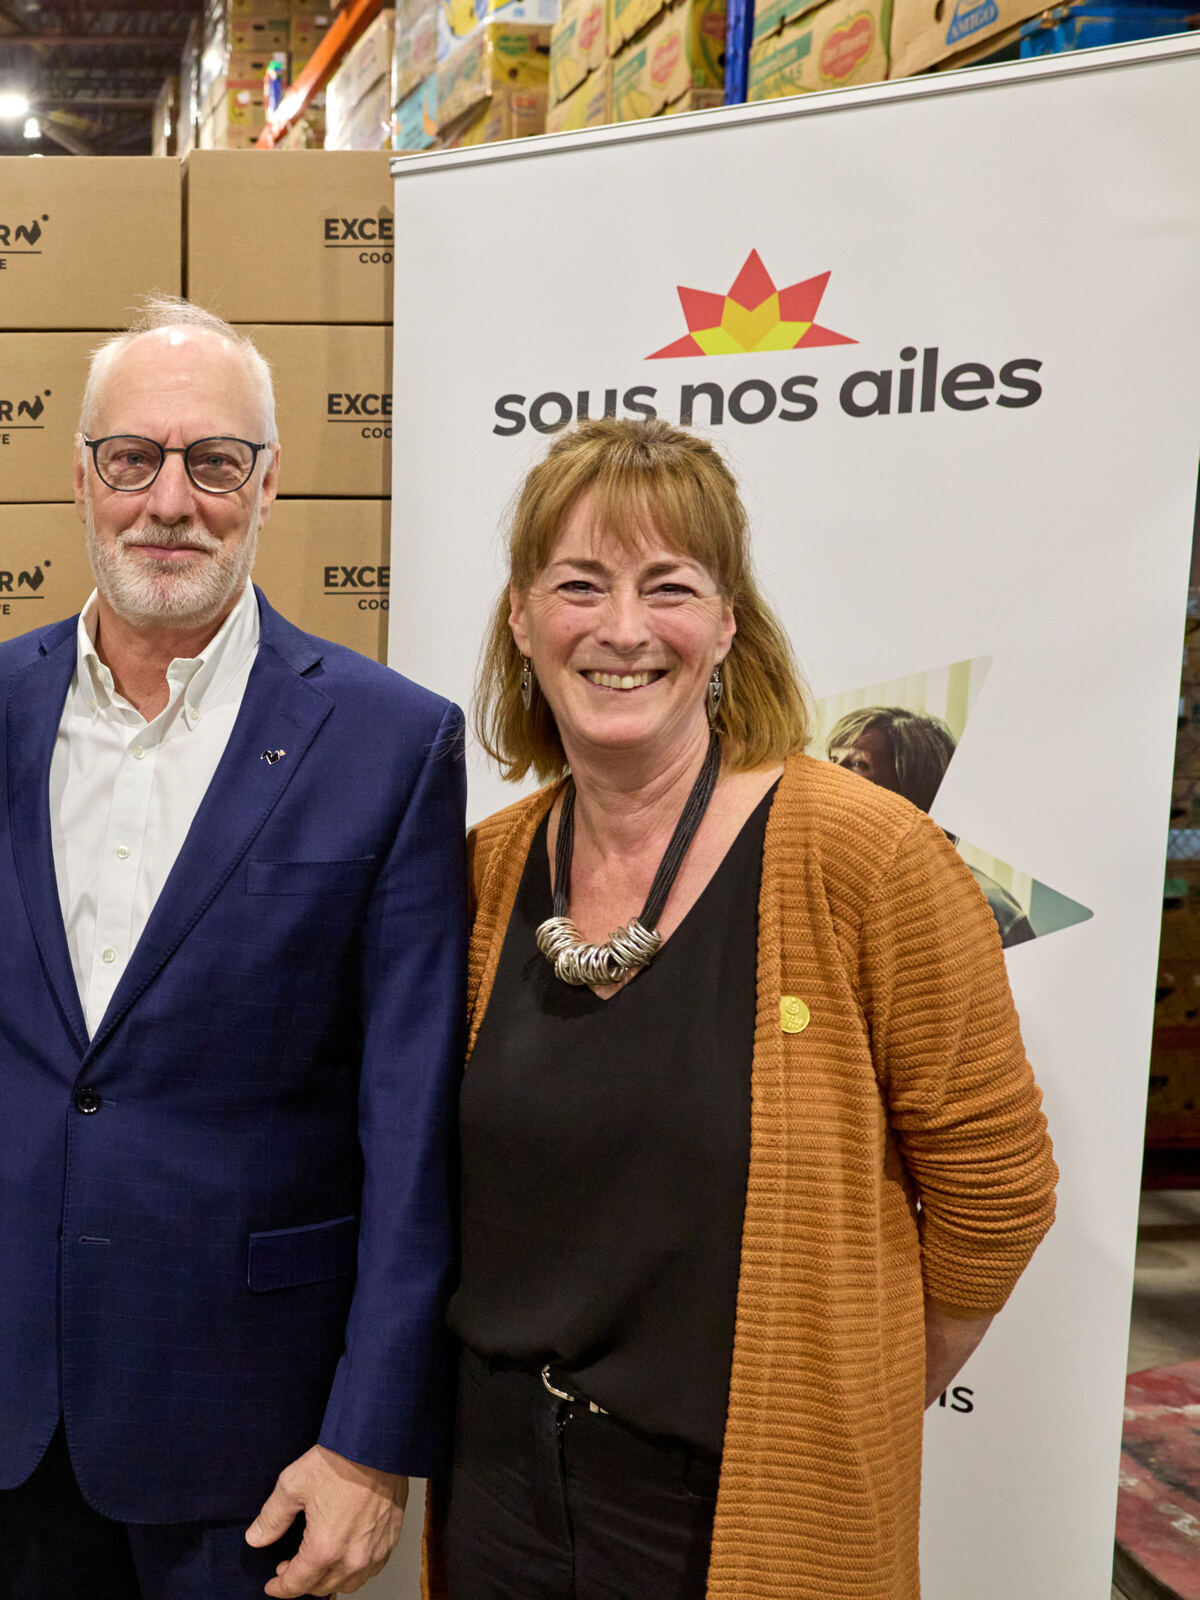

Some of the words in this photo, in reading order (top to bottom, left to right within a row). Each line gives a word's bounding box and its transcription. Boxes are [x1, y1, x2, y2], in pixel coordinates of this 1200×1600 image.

[493, 386, 658, 437] sous
[679, 375, 819, 426] nos
[839, 346, 1043, 418] ailes
